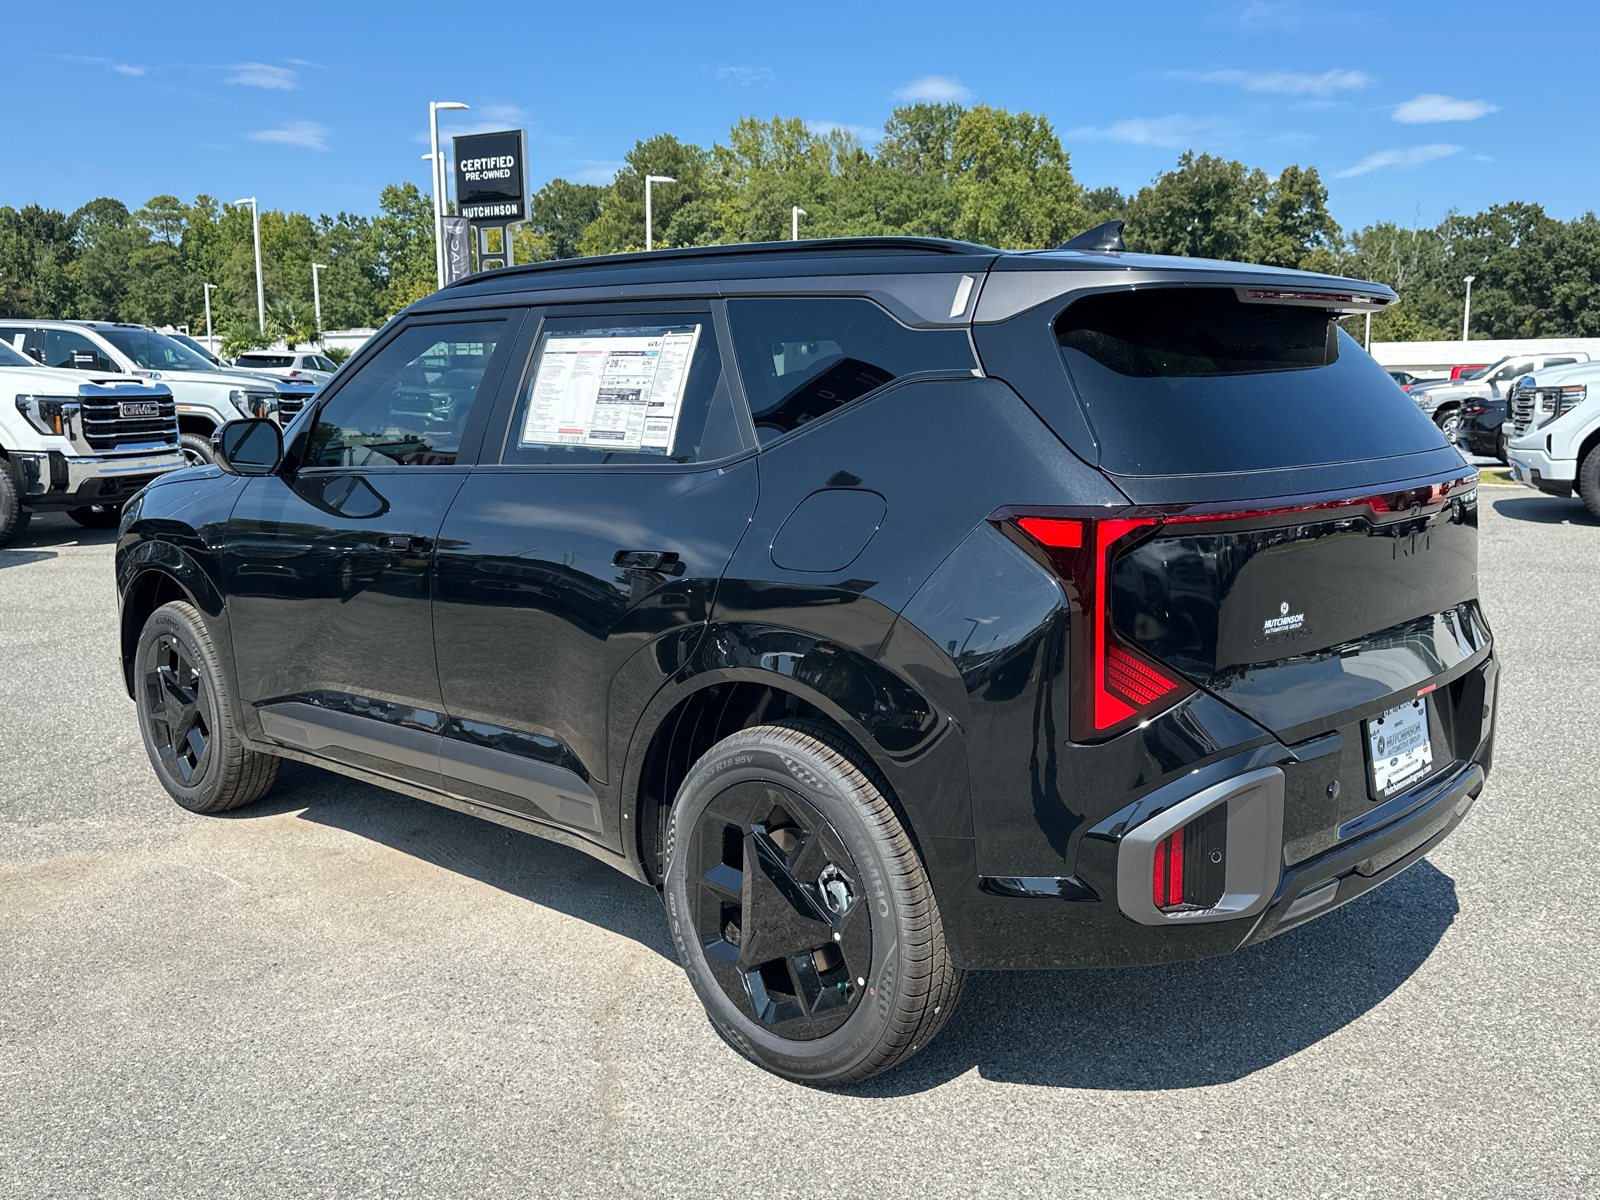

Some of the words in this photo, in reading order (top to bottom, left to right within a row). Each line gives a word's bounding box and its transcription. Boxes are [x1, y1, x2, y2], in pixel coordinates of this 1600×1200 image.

[460, 155, 515, 172] CERTIFIED
[465, 168, 511, 181] PRE-OWNED
[462, 204, 518, 218] HUTCHINSON
[609, 358, 620, 368] 28
[123, 403, 159, 416] GMC
[1392, 526, 1433, 560] KIA
[155, 616, 180, 631] KUMHO
[1264, 614, 1304, 629] HUTCHINSON
[1386, 721, 1422, 749] HUTCHINSON
[716, 759, 734, 772] R18
[734, 755, 754, 765] 95V
